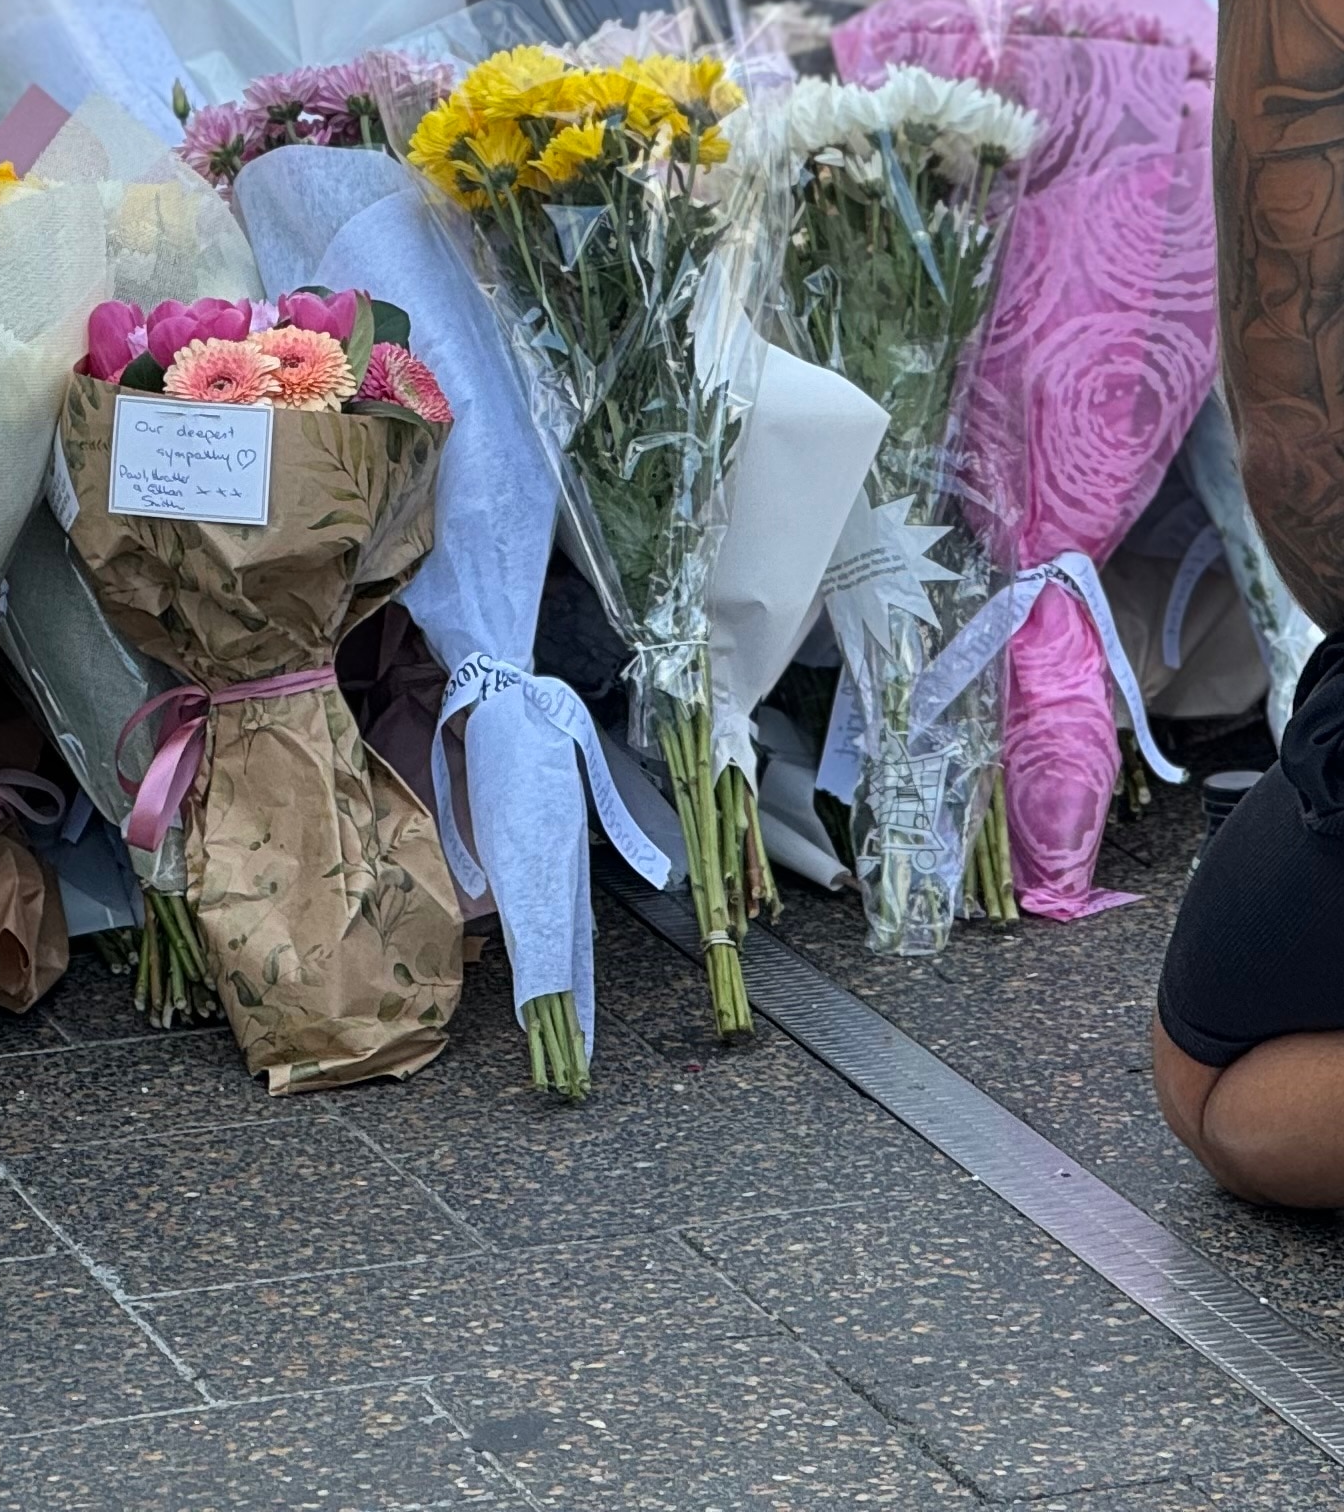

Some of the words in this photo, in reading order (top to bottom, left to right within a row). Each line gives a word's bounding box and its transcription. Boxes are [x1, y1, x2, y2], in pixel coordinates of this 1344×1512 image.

[135, 421, 163, 434] Our
[176, 424, 234, 445] deepest
[156, 448, 233, 472] sympathy
[141, 496, 186, 511] Smith
